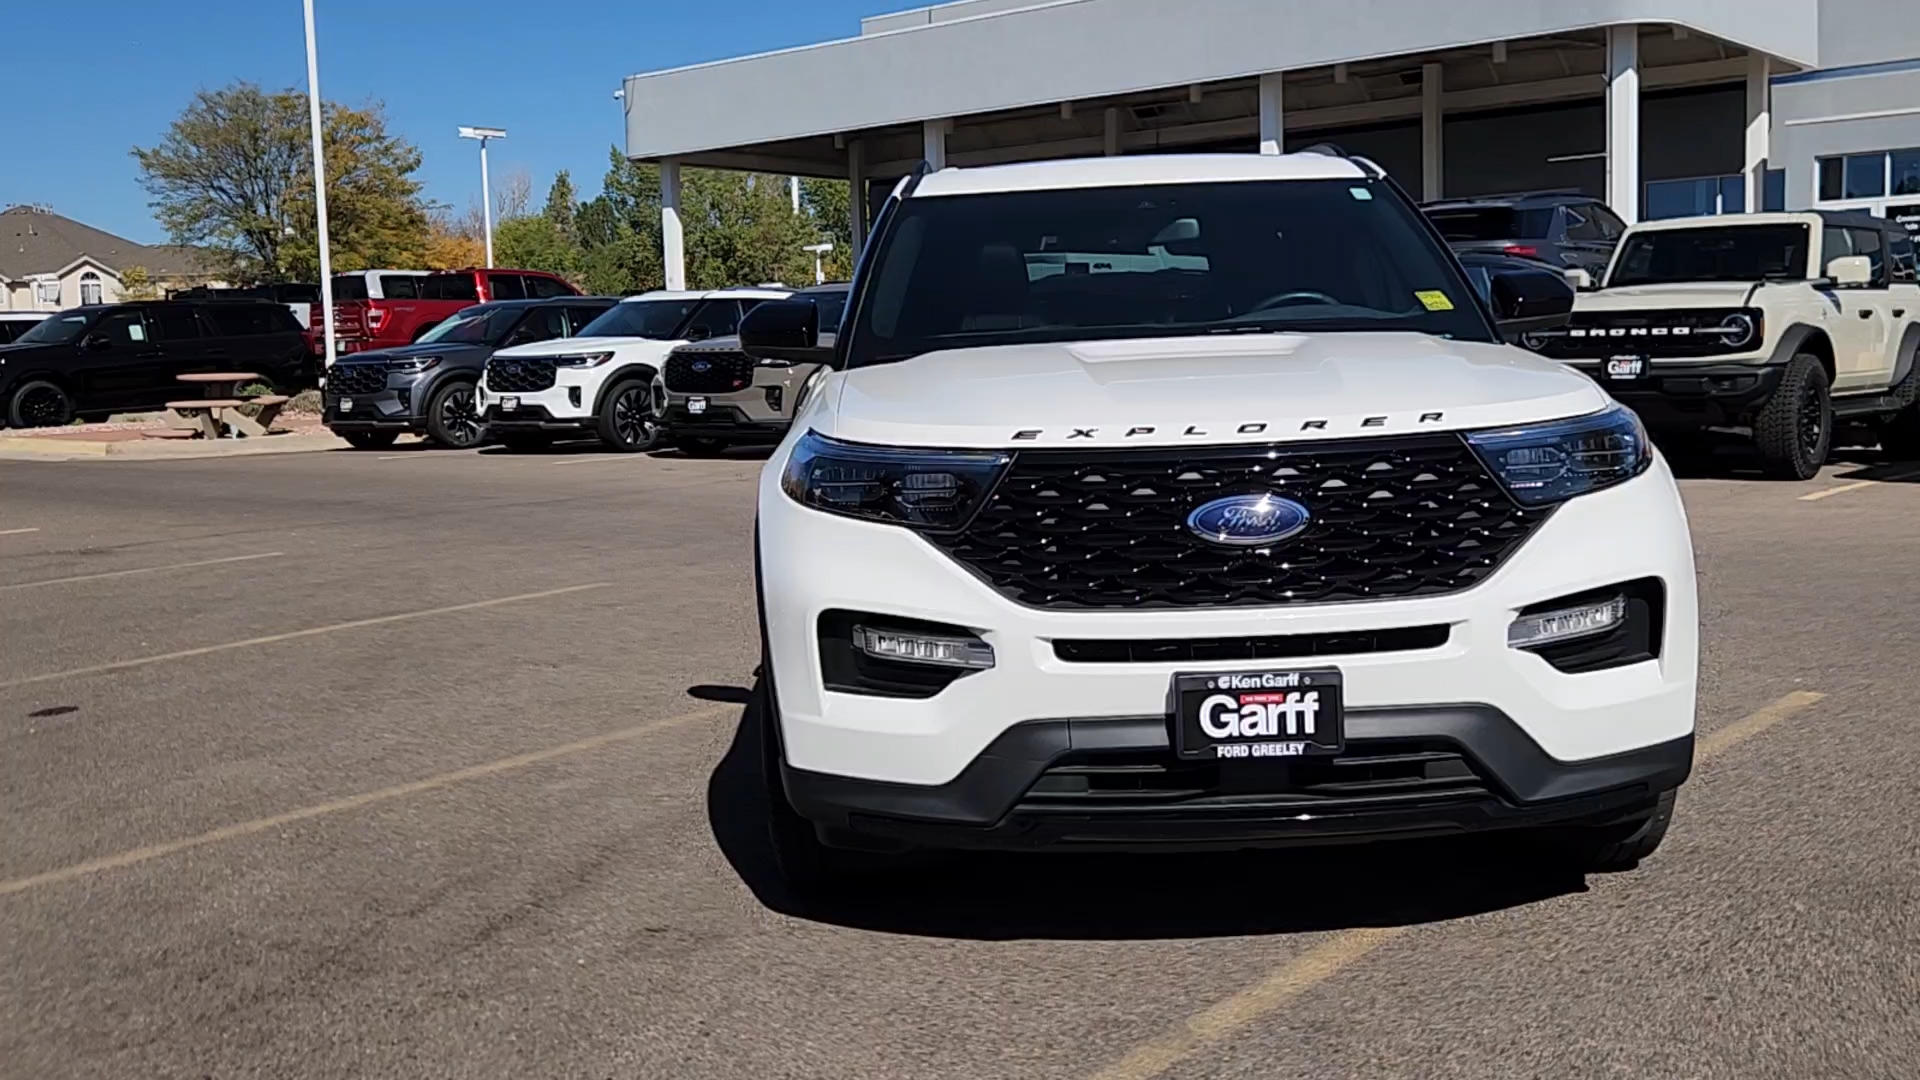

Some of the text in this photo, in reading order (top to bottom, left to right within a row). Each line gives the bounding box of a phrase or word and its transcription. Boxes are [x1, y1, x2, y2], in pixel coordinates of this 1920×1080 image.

[1570, 327, 1690, 337] BRONCO
[1608, 360, 1642, 374] Garff
[1011, 412, 1444, 440] EXPLORER
[1217, 505, 1281, 531] Ford
[1231, 673, 1299, 689] Ken Garff
[1200, 691, 1319, 739] Garff
[1217, 743, 1305, 758] FORD GREELEY
